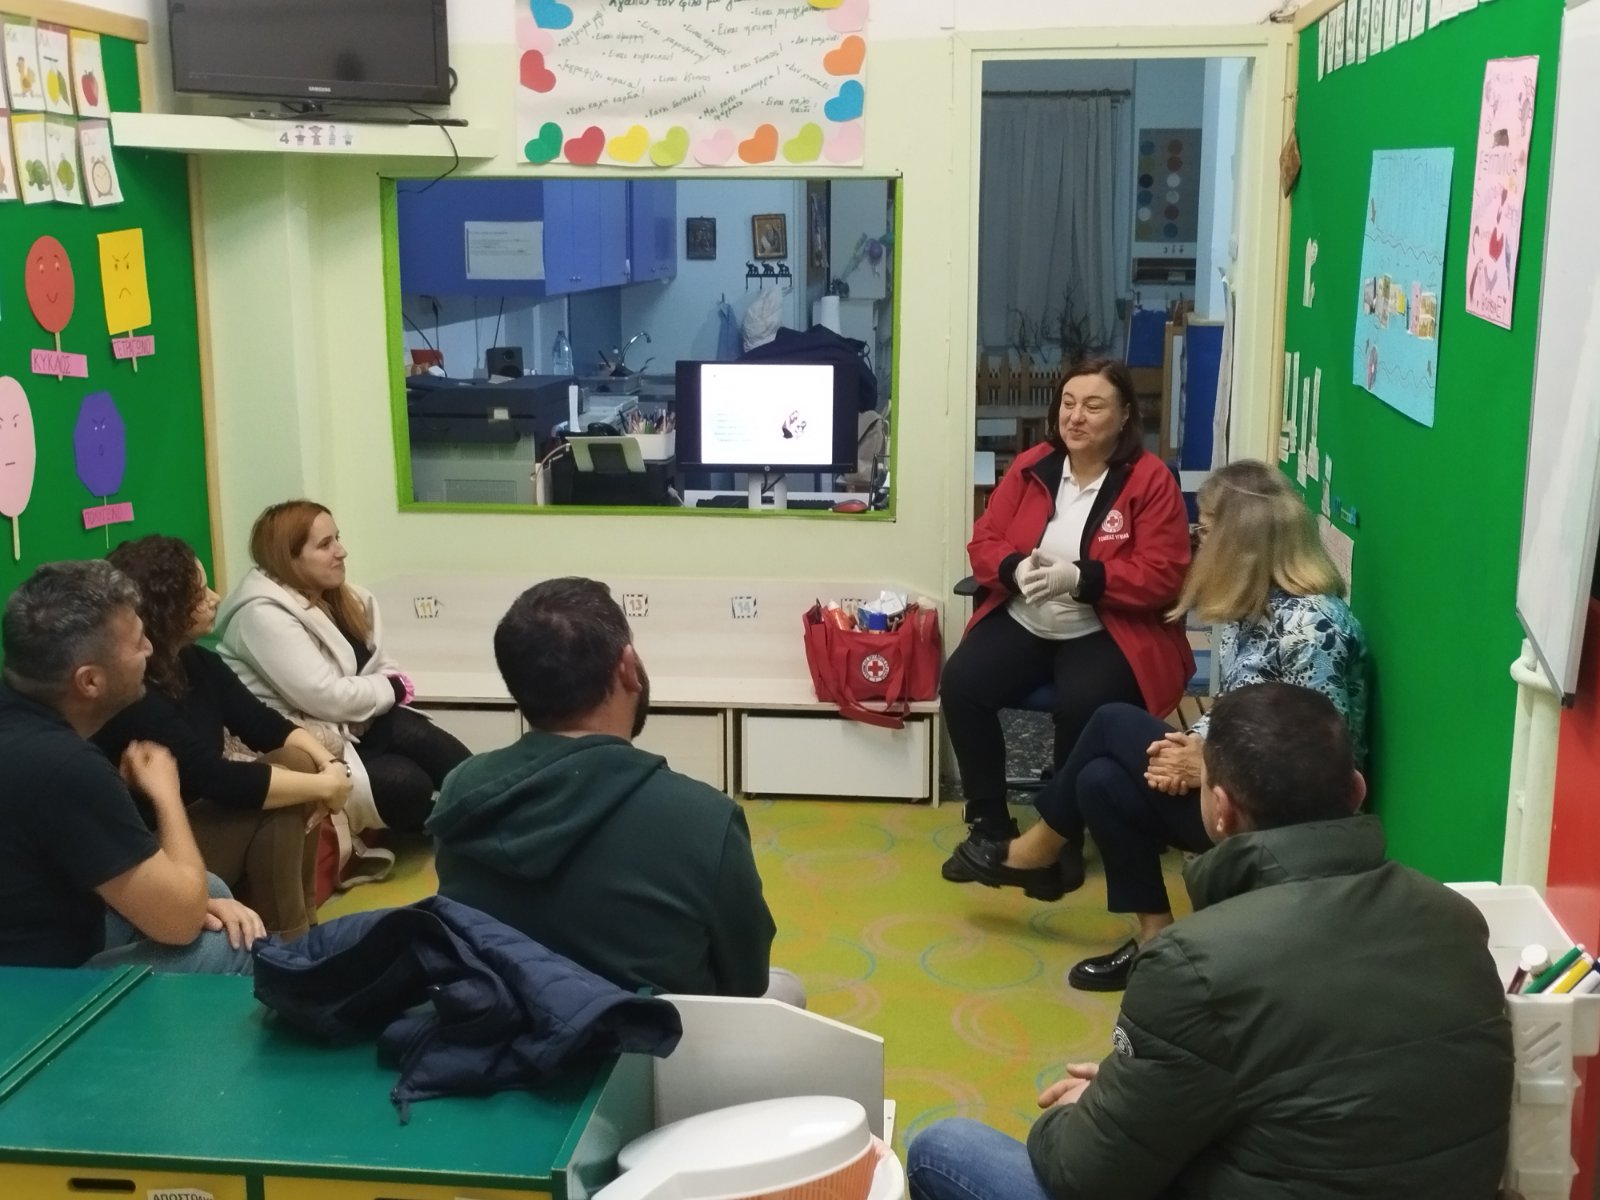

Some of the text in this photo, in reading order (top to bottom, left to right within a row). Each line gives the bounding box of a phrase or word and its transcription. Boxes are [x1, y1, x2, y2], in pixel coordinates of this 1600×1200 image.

[1347, 9, 1356, 45] 4
[1360, 7, 1368, 44] 5
[1373, 0, 1381, 36] 6
[1337, 15, 1344, 51] 3
[279, 132, 290, 145] 4
[420, 601, 433, 614] 11
[629, 598, 643, 612] 13
[738, 602, 751, 614] 14
